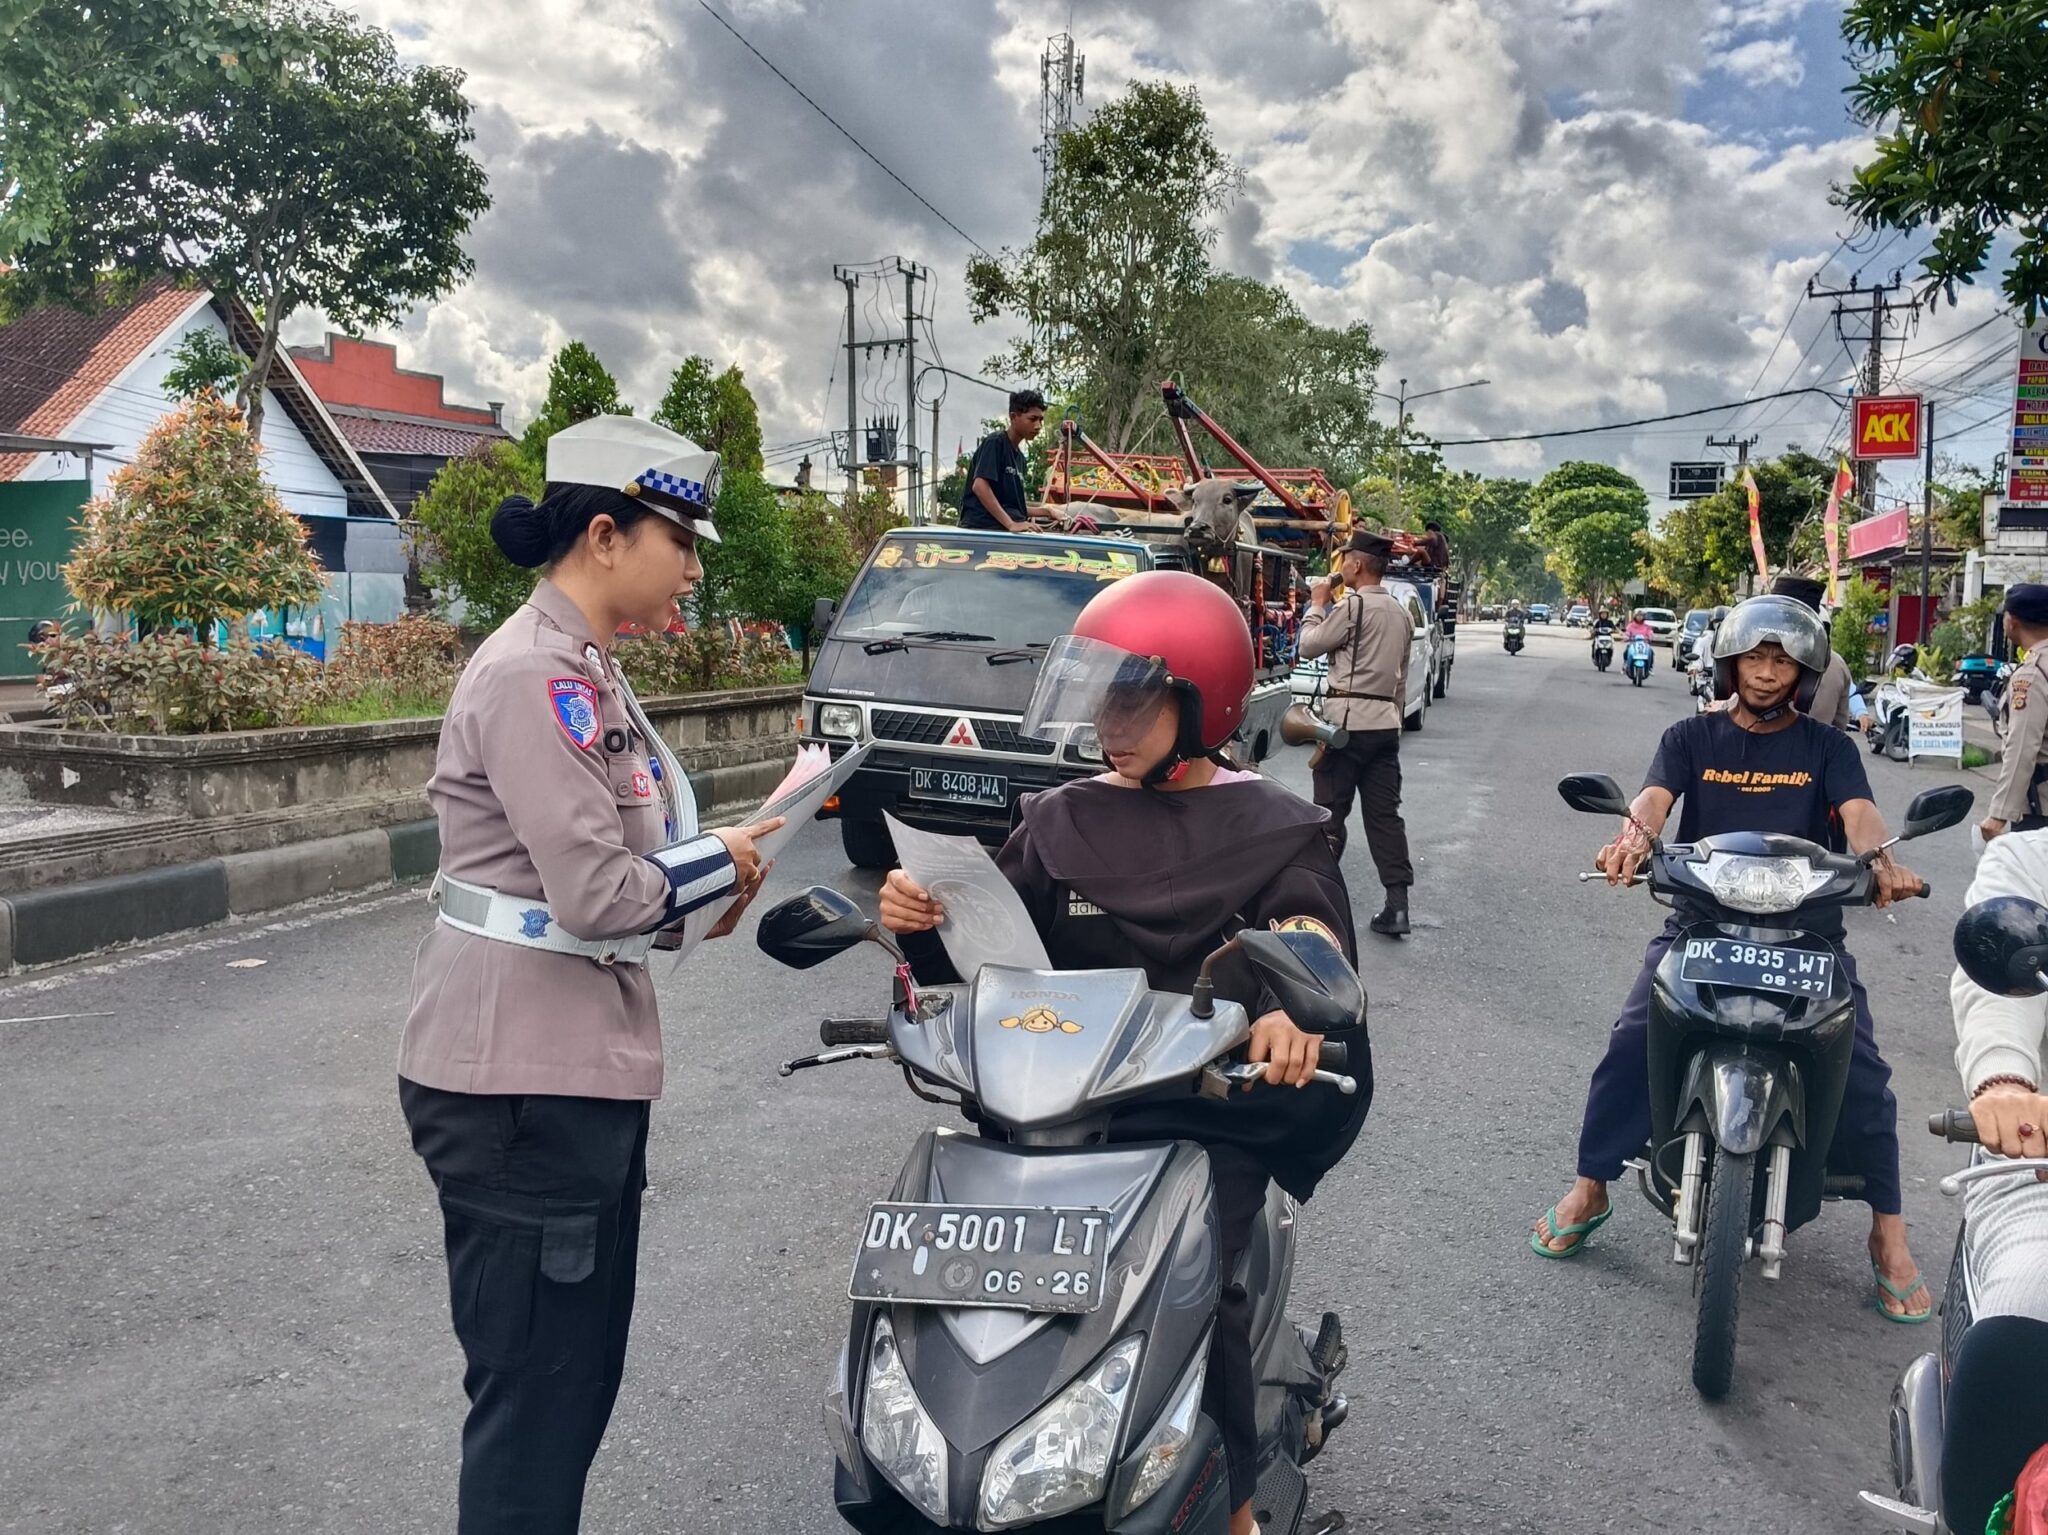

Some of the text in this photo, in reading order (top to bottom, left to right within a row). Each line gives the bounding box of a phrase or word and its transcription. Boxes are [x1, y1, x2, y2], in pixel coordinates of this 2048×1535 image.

[1863, 413, 1911, 442] ACK
[553, 680, 573, 690] LALU
[915, 770, 999, 796] DK 8408 WA
[1702, 768, 1750, 785] Rebel
[1687, 941, 1829, 975] DK 3835 WT
[1010, 990, 1081, 1001] HONDA
[865, 1211, 1102, 1255] DK 5001 LT
